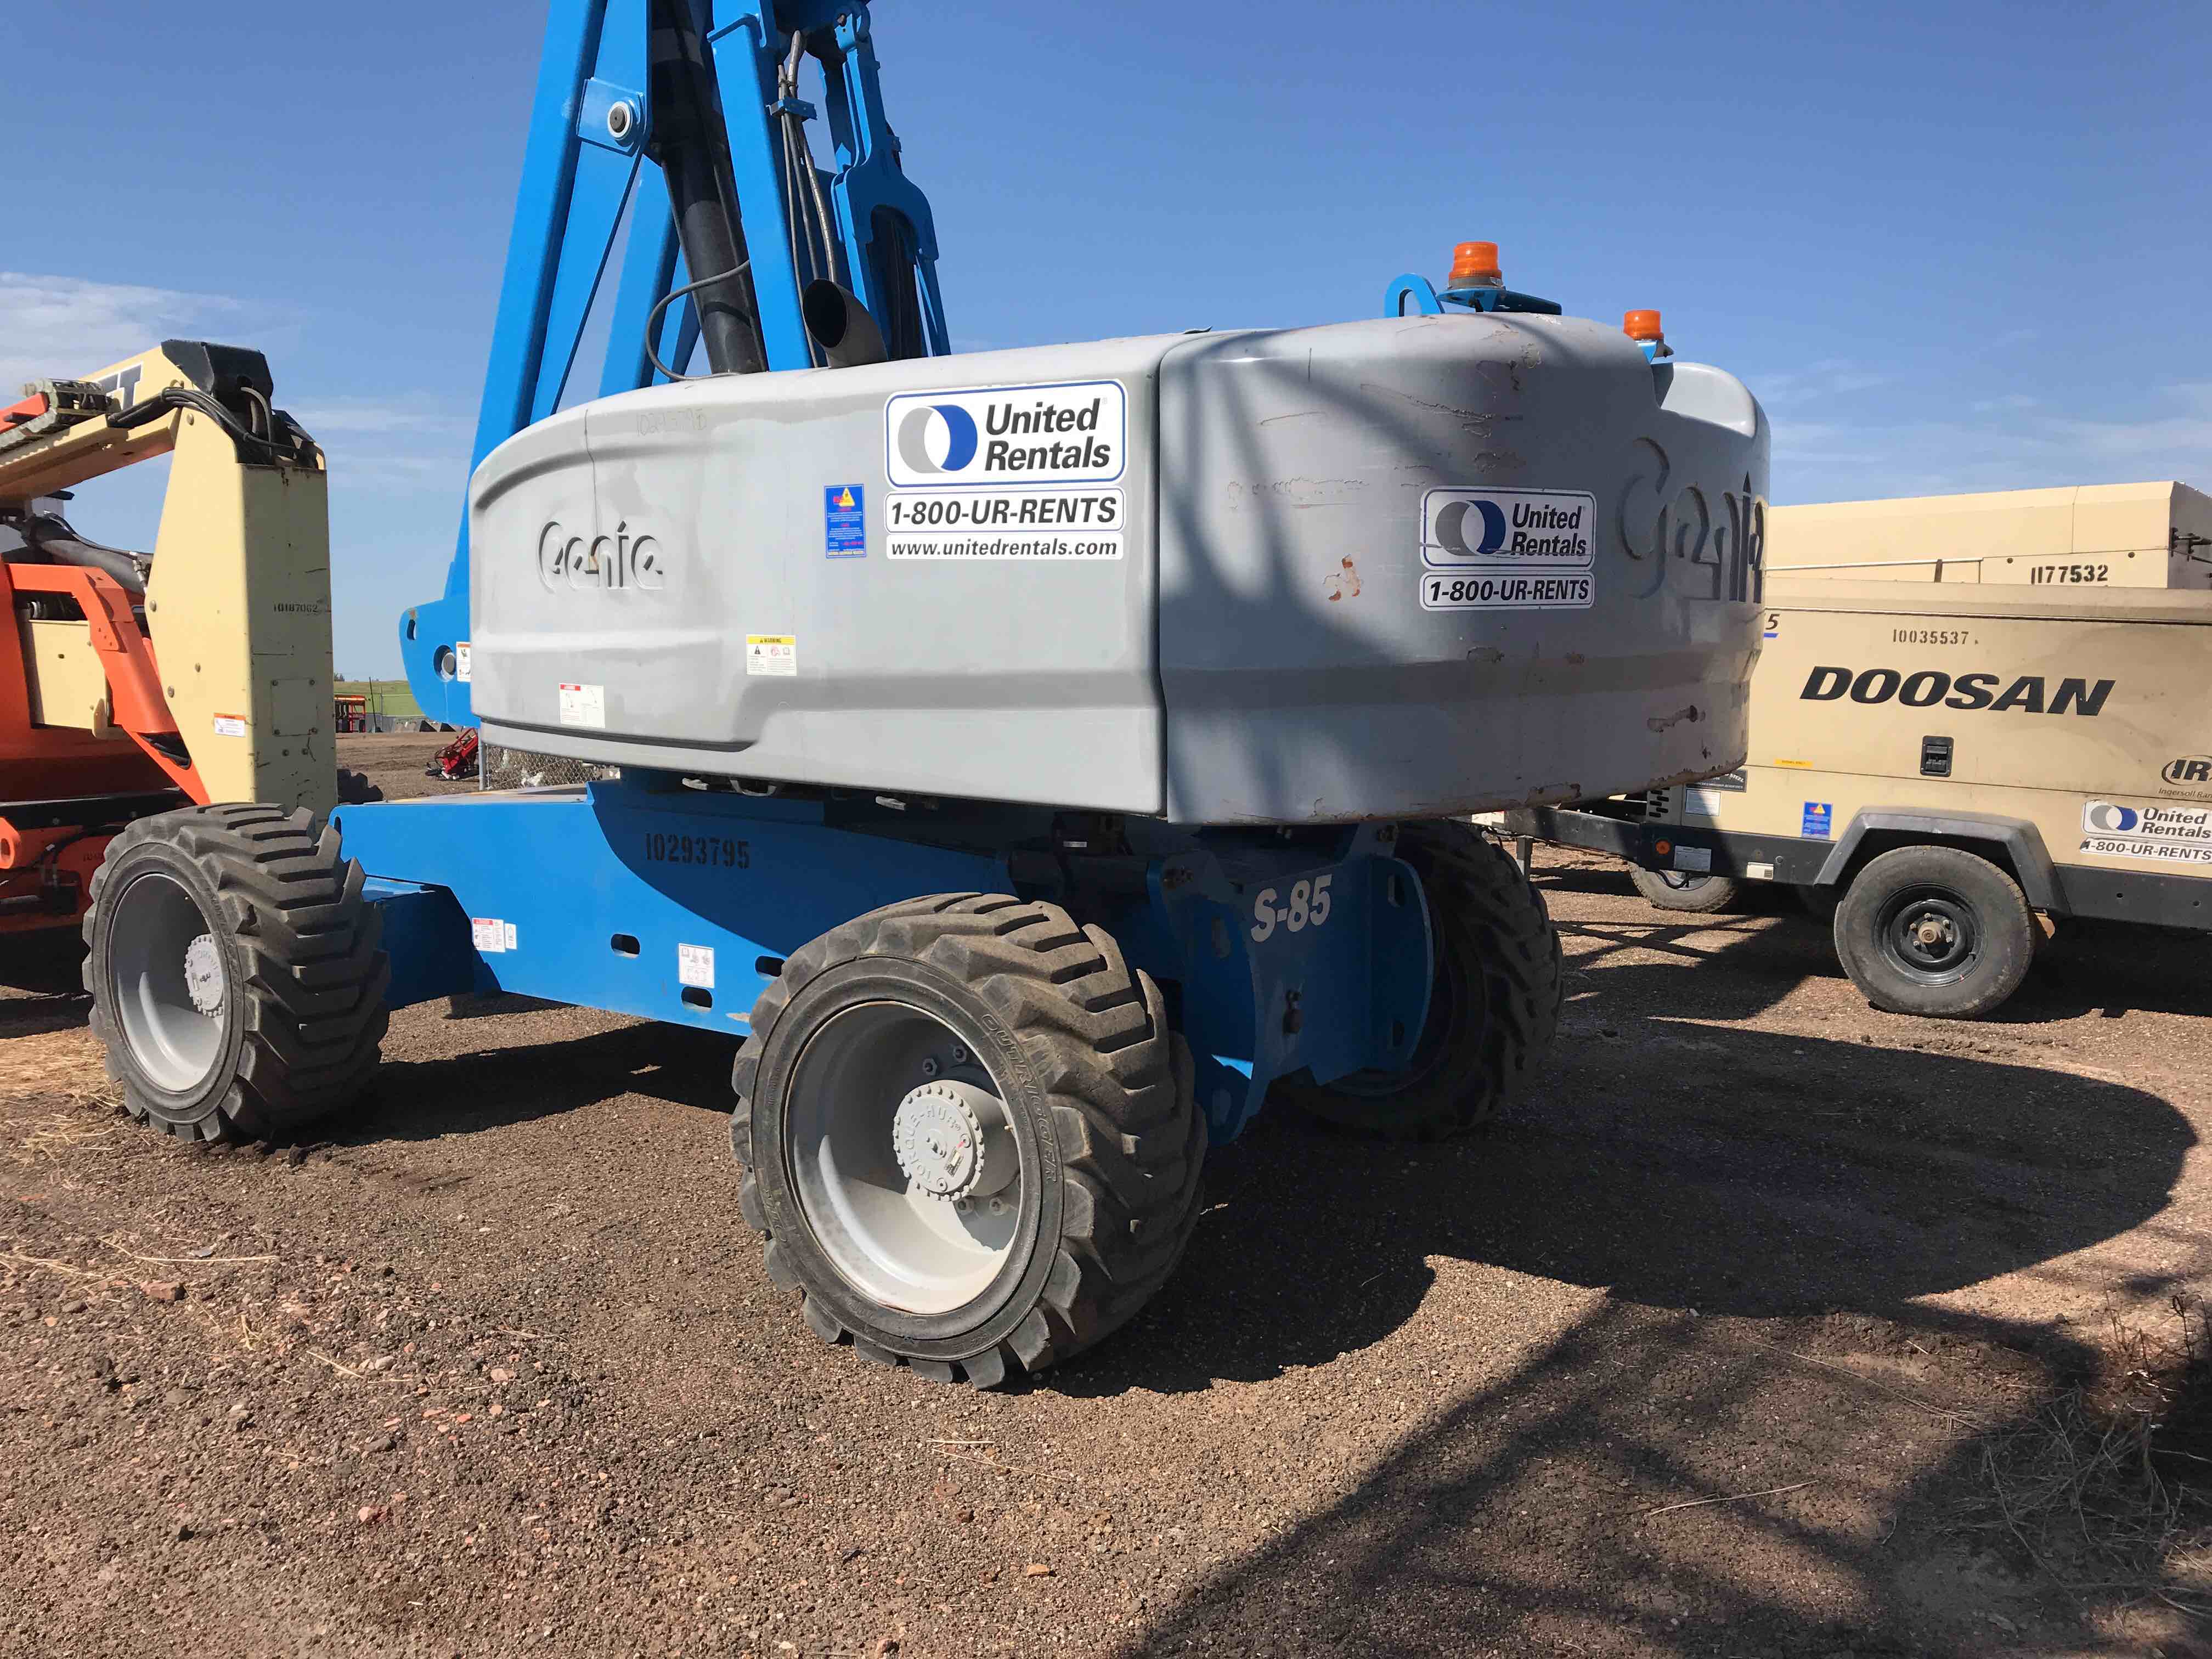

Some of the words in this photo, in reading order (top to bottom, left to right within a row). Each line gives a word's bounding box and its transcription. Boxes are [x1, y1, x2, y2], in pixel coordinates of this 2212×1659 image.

[986, 398, 1101, 435] United
[985, 436, 1111, 471] Rentals
[891, 496, 1117, 525] 1-800-UR-RENTS
[1512, 503, 1582, 529] United
[891, 538, 1118, 556] www.unitedrentals.com
[1510, 531, 1587, 556] Rentals
[537, 520, 663, 592] Genie
[2031, 563, 2108, 585] 1177532
[1430, 579, 1589, 602] 1-800-UR-RENTS
[1893, 629, 1970, 645] 10035537
[1799, 665, 2117, 716] DOOSAN
[2171, 759, 2212, 782] IR
[2158, 787, 2196, 798] Ingersoll
[2143, 807, 2208, 825] United
[2141, 821, 2212, 839] Rentals
[646, 833, 751, 870] 10293795
[2084, 840, 2212, 861] 1-800-UR-RENTS
[1250, 873, 1333, 943] S-85
